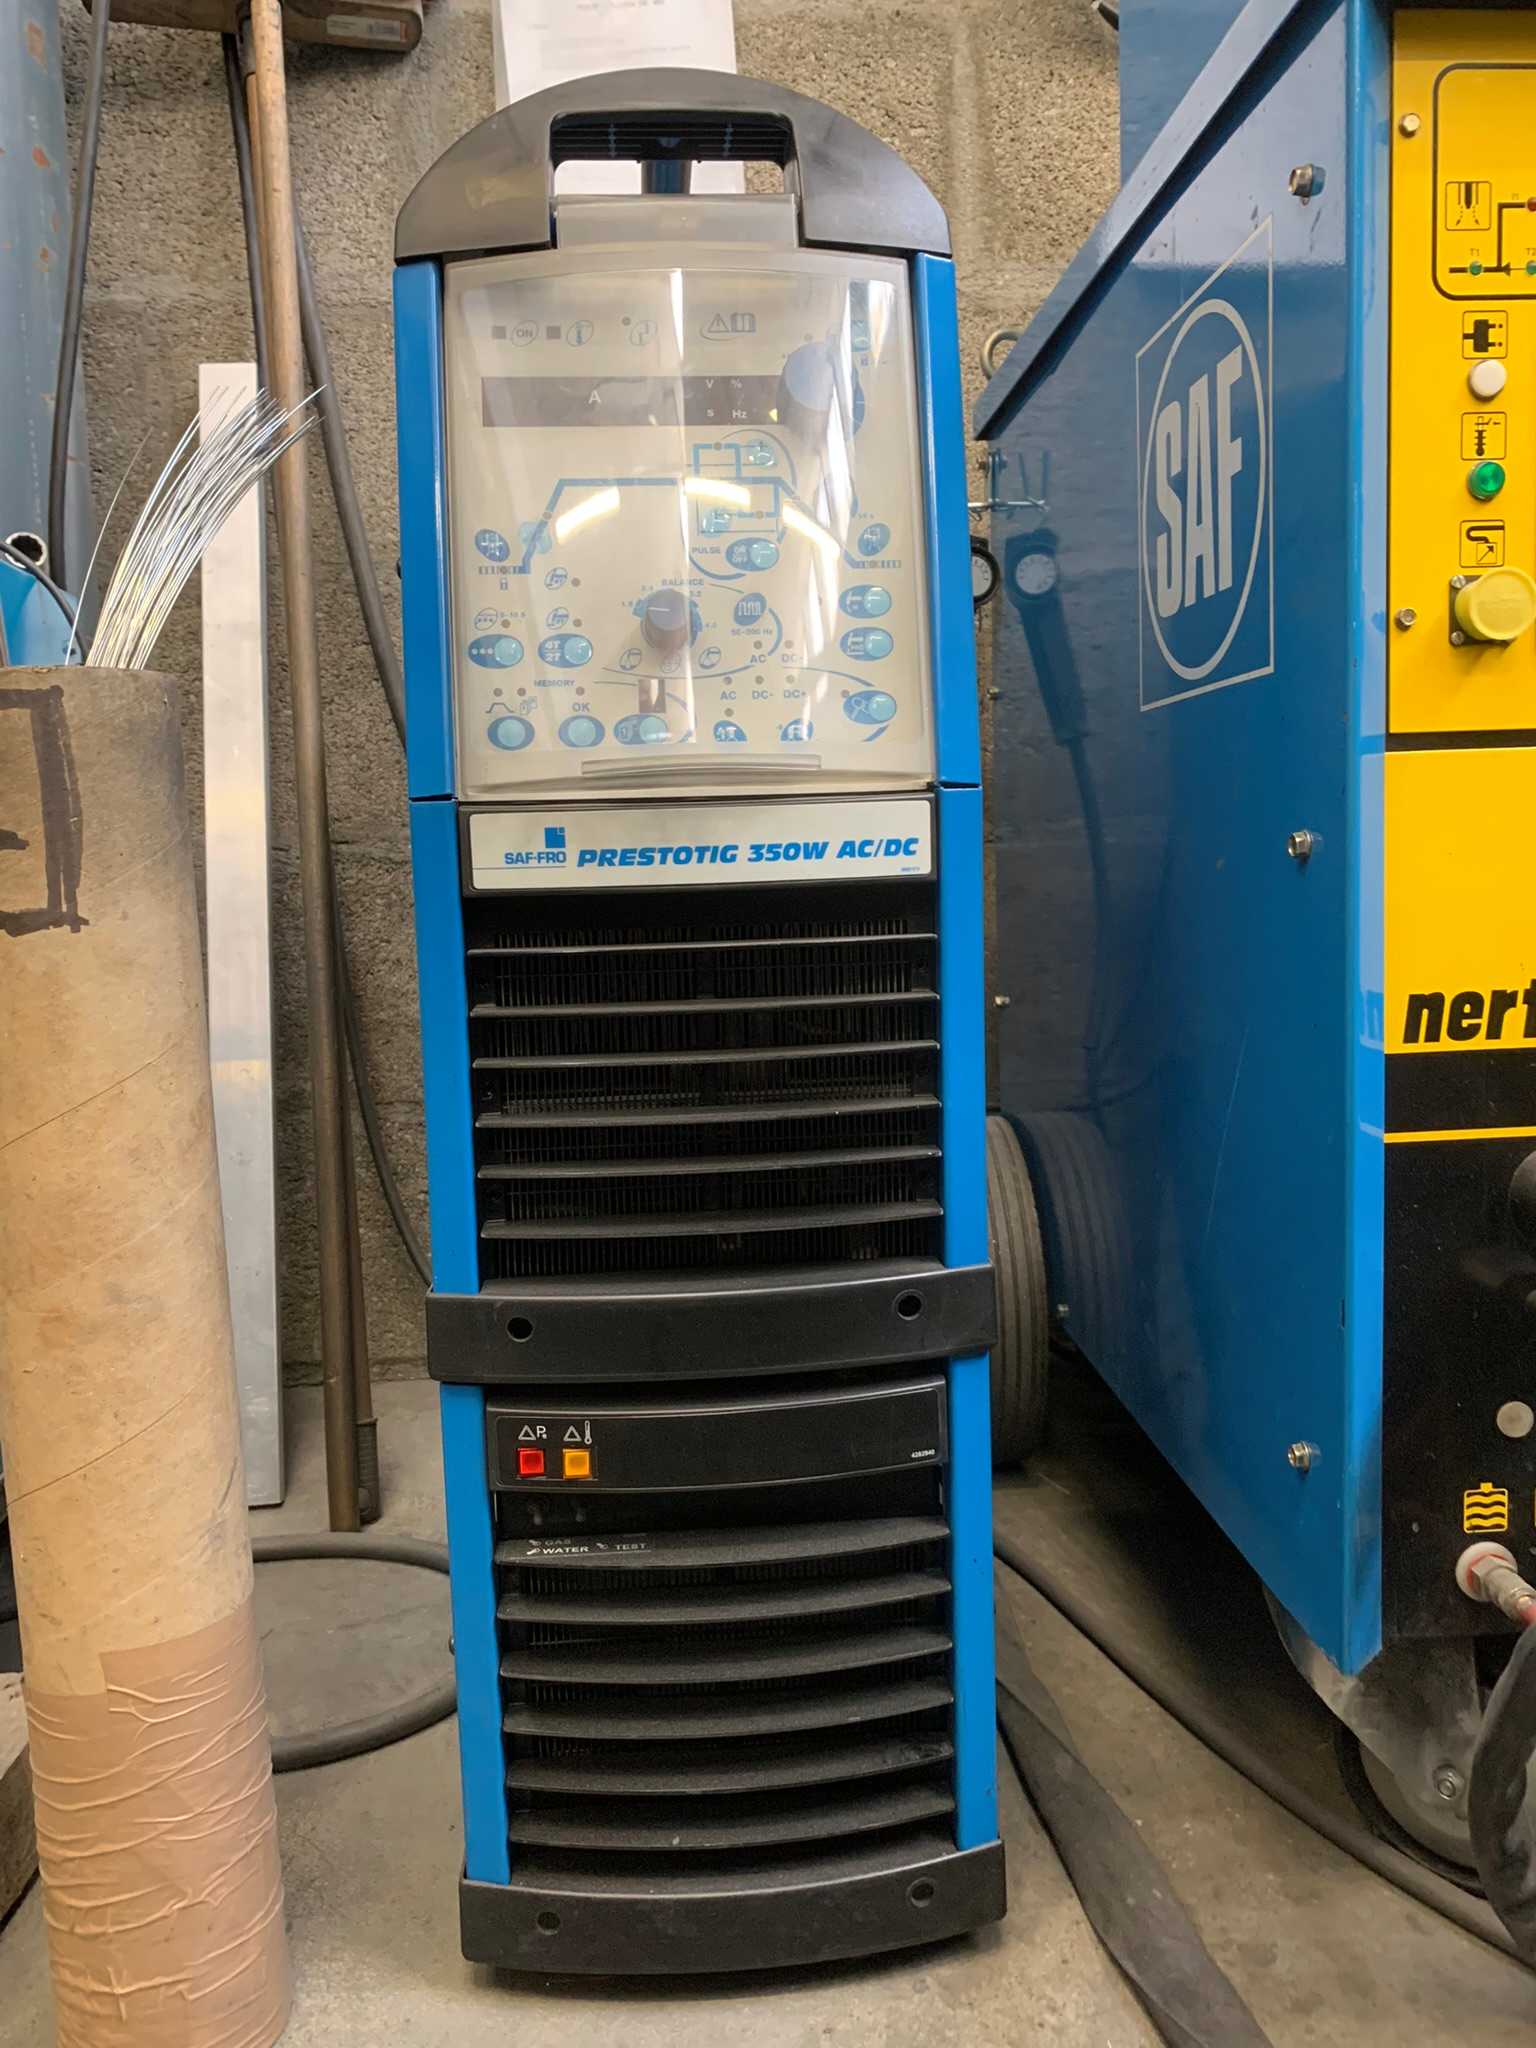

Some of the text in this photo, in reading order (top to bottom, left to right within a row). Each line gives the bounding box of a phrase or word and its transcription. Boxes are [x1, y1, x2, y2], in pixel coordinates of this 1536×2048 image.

[515, 329, 533, 338] ON
[588, 389, 602, 405] A
[731, 409, 748, 419] Hz
[1156, 343, 1243, 620] SAF
[691, 546, 721, 555] PULSE
[750, 653, 767, 664] AC
[533, 679, 576, 688] MEMORY
[720, 690, 737, 700] AC
[571, 702, 591, 713] OK
[504, 837, 919, 868] SAF-FRO PRESTOTIG 350W AC/DC
[542, 1545, 590, 1555] WATER
[614, 1542, 647, 1551] TEST
